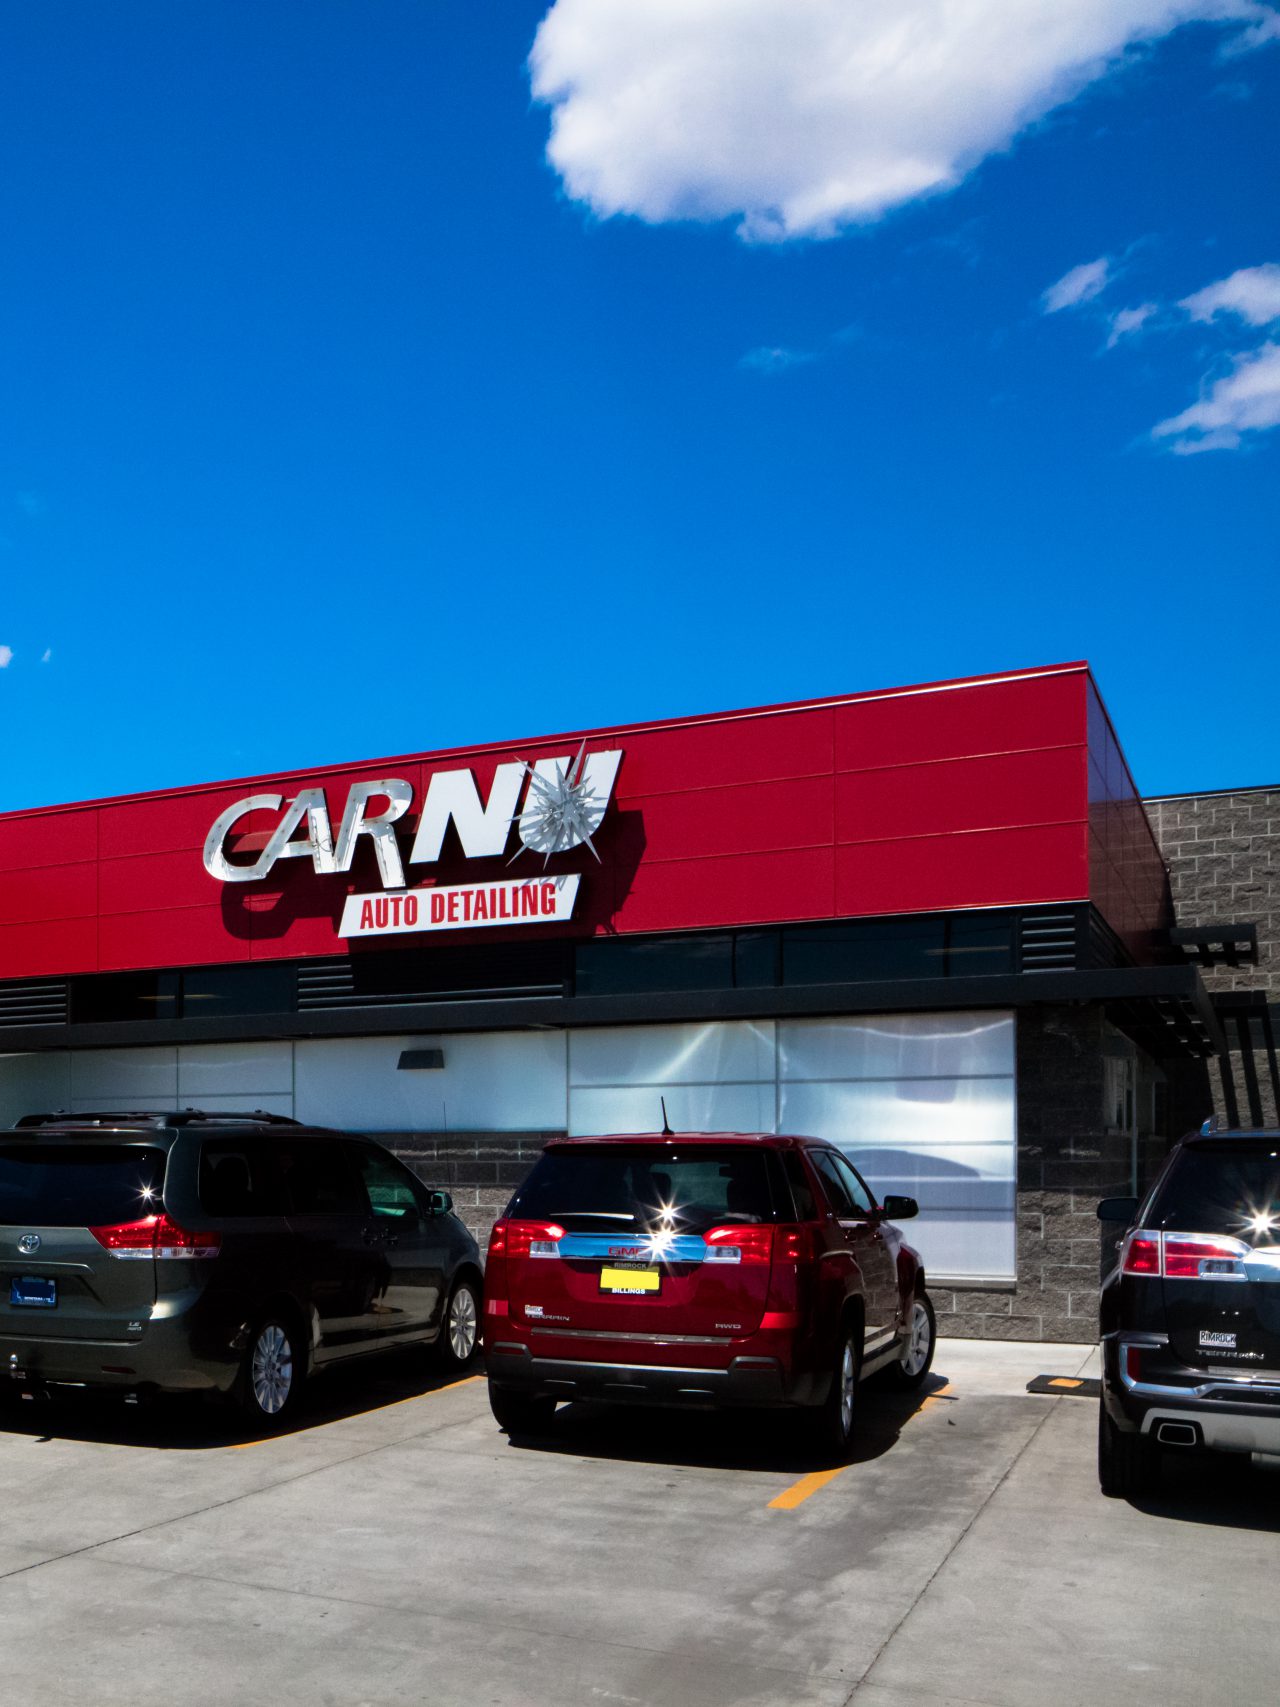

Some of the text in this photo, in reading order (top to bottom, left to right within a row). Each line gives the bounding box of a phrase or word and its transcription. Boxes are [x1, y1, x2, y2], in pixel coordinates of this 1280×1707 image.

[359, 882, 557, 930] AUTO DETAILING
[611, 1287, 646, 1295] BILLINGS
[1201, 1332, 1236, 1343] RIMROCK
